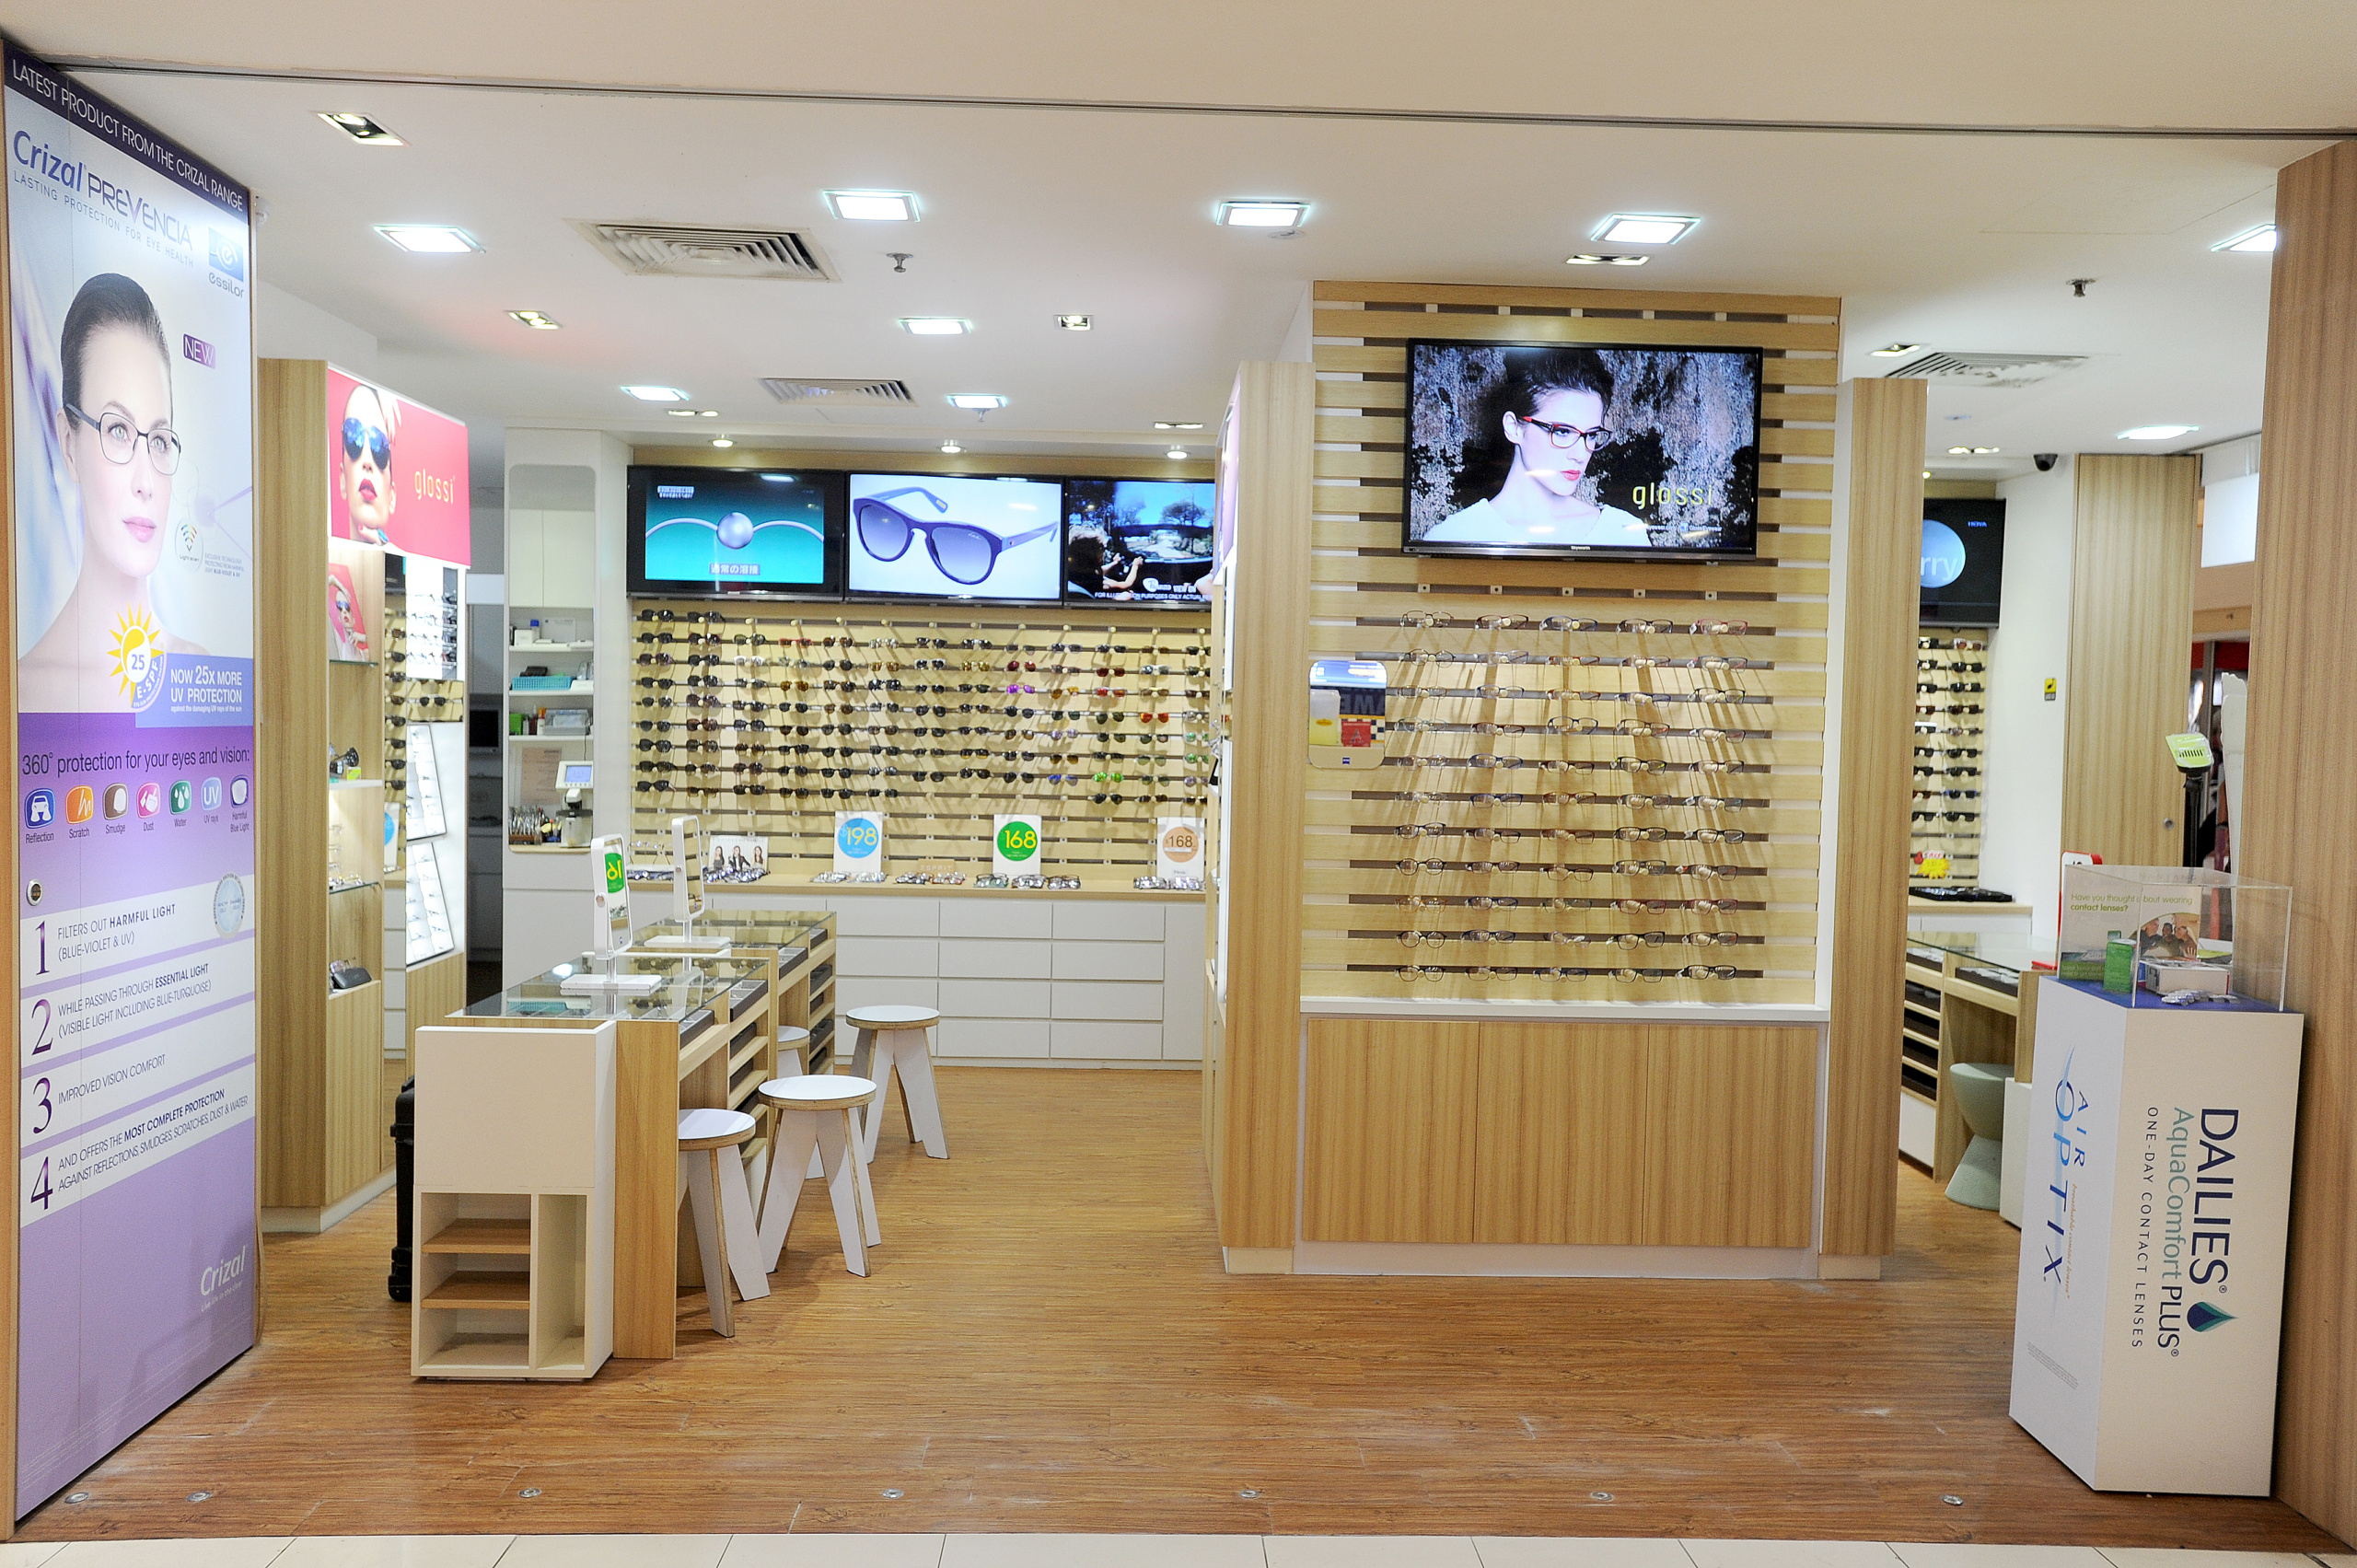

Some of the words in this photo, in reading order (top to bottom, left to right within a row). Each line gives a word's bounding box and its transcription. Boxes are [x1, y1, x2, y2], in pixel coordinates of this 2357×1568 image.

[13, 59, 57, 101] LATEST
[61, 89, 120, 137] PRODUCT
[122, 125, 155, 158] FROM
[156, 145, 174, 170] THE
[176, 159, 210, 192] CRIZAL
[211, 179, 243, 212] RANGE
[13, 130, 86, 192] Crizal
[14, 170, 58, 201] LASTING
[64, 195, 120, 231] PROTECTION
[125, 226, 142, 243] FOR
[146, 237, 161, 252] EYE
[166, 243, 194, 268] HEALTH
[208, 272, 244, 298] essilor
[184, 336, 215, 366] NEW
[414, 469, 454, 504] glossi
[1632, 482, 1713, 509] glossi
[132, 654, 145, 670] 25
[170, 668, 194, 685] NOW
[217, 671, 243, 686] MORE
[170, 688, 184, 703] UV
[187, 688, 242, 704] PROTECTION
[57, 750, 122, 779] protection
[126, 749, 142, 769] for
[145, 752, 169, 772] your
[172, 751, 196, 771] eyes
[199, 746, 218, 764] and
[220, 746, 250, 763] vision:
[203, 785, 219, 806] UV
[25, 831, 54, 844] Reflection
[68, 828, 90, 839] Scratch
[105, 823, 126, 835] Smudge
[1004, 830, 1037, 849] 168
[58, 922, 88, 940] FILTERS
[90, 918, 108, 932] OUT
[110, 911, 149, 929] HARMFUL
[152, 903, 176, 919] LIGHT
[2071, 893, 2090, 901] Have
[2107, 894, 2135, 903] thought
[2162, 897, 2193, 905] wearing
[2100, 903, 2129, 912] lenses?
[35, 921, 50, 976] 1
[58, 935, 111, 962] (BLUE-VIOLET
[112, 935, 120, 947] &
[121, 930, 135, 946] UV)
[58, 998, 83, 1017] WHILE
[85, 990, 118, 1010] PASSING
[118, 979, 154, 998] THROUGH
[155, 970, 189, 990] ESSENTIAL
[190, 963, 209, 980] LIGHT
[58, 1018, 89, 1040] (VISIBLE
[91, 1013, 114, 1028] LIGHT
[115, 998, 156, 1020] INCLUDING
[157, 979, 212, 1008] BLUE-TURQUOISE)
[31, 998, 53, 1056] 2
[58, 1078, 101, 1105] IMPROVED
[101, 1069, 128, 1087] VISION
[129, 1054, 167, 1077] COMFORT
[32, 1077, 52, 1134] 3
[58, 1154, 77, 1171] AND
[79, 1139, 109, 1161] OFFERS
[109, 1132, 123, 1149] THE
[123, 1123, 146, 1143] MOST
[146, 1107, 183, 1132] COMPLETE
[184, 1088, 226, 1115] PROTECTION
[2074, 1090, 2089, 1168] AIR
[58, 1166, 92, 1192] AGAINST
[209, 1107, 224, 1122] DUST
[225, 1103, 230, 1115] &
[230, 1095, 249, 1112] WATER
[2142, 1107, 2159, 1184] ONE-DAY
[30, 1156, 53, 1211] 4
[2043, 1079, 2075, 1284] OPTIX
[2161, 1107, 2195, 1280] AquaComfort
[2136, 1191, 2153, 1272] CONTACT
[201, 1245, 246, 1296] Crizal
[2131, 1282, 2146, 1348] LENSES
